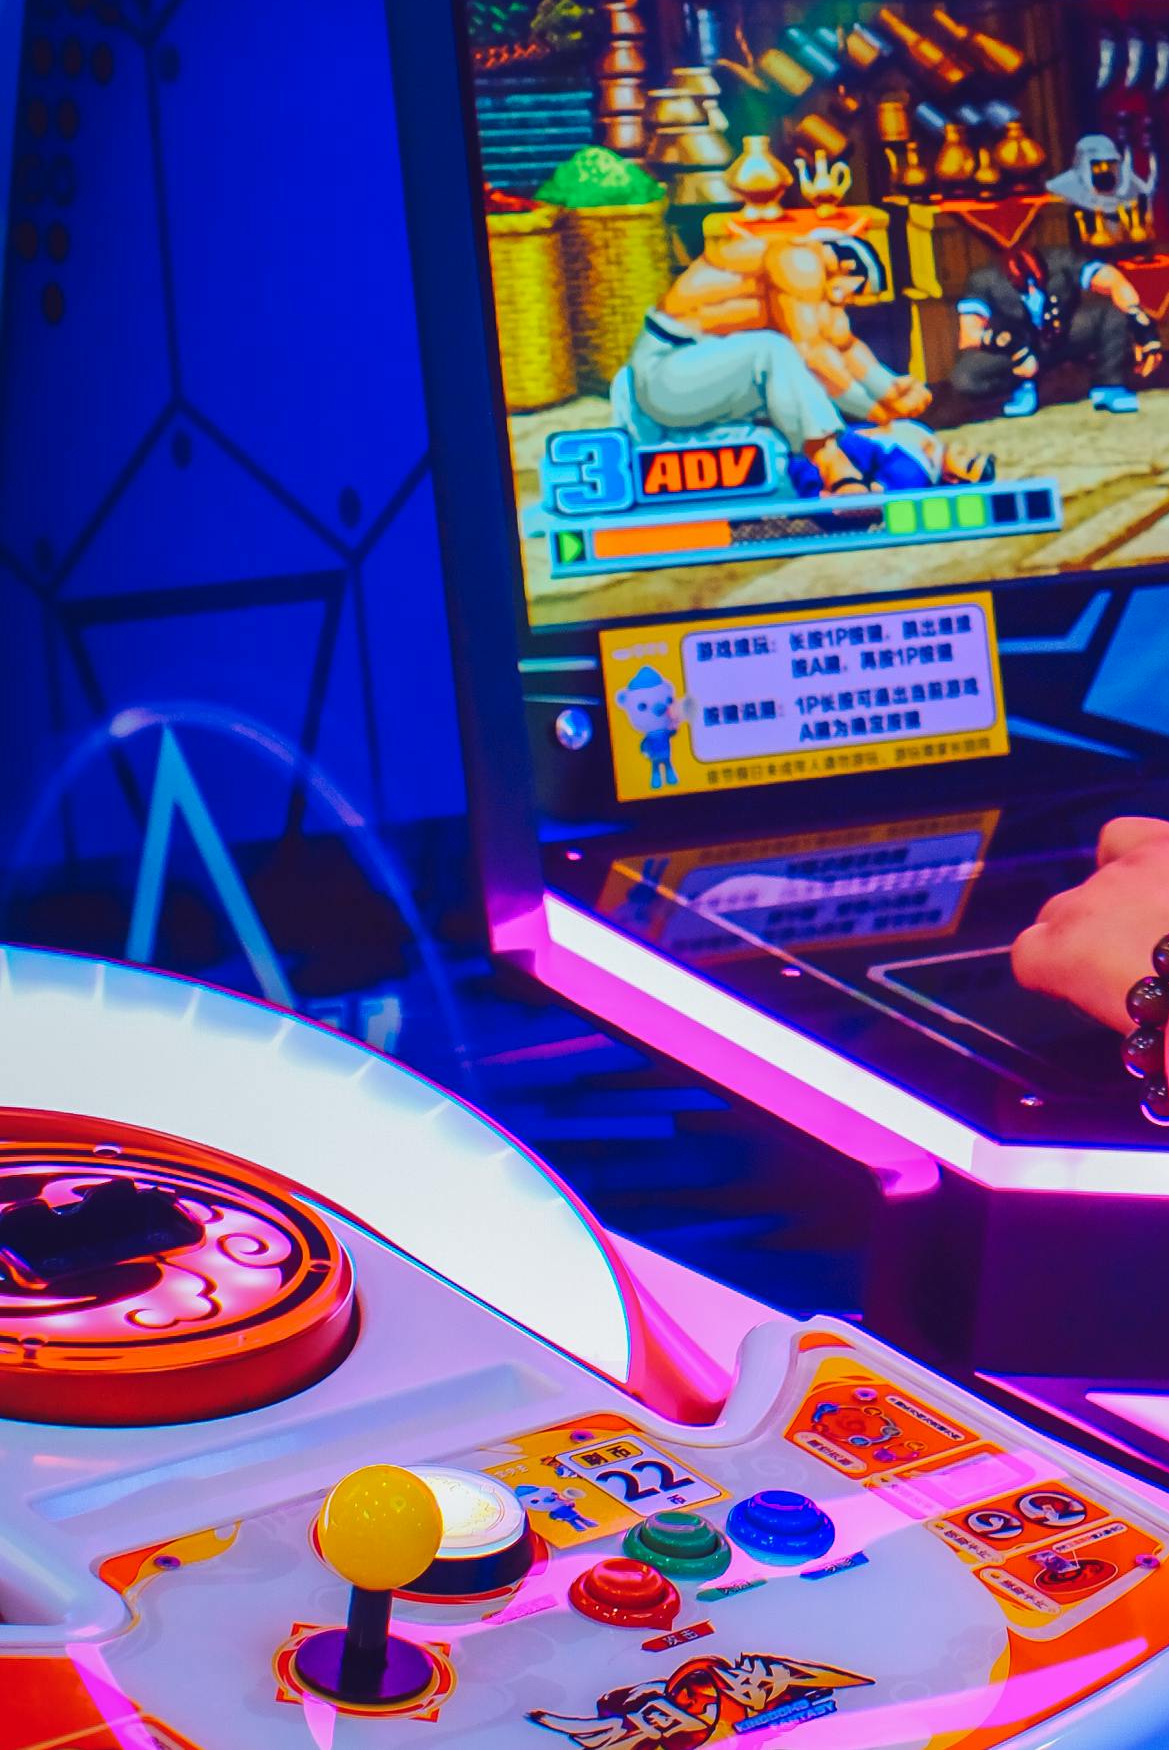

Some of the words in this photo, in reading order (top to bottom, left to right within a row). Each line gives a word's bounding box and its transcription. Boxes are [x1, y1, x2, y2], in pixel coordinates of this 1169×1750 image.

[547, 428, 636, 516] 3
[643, 445, 757, 496] ADV
[595, 1460, 695, 1502] 22
